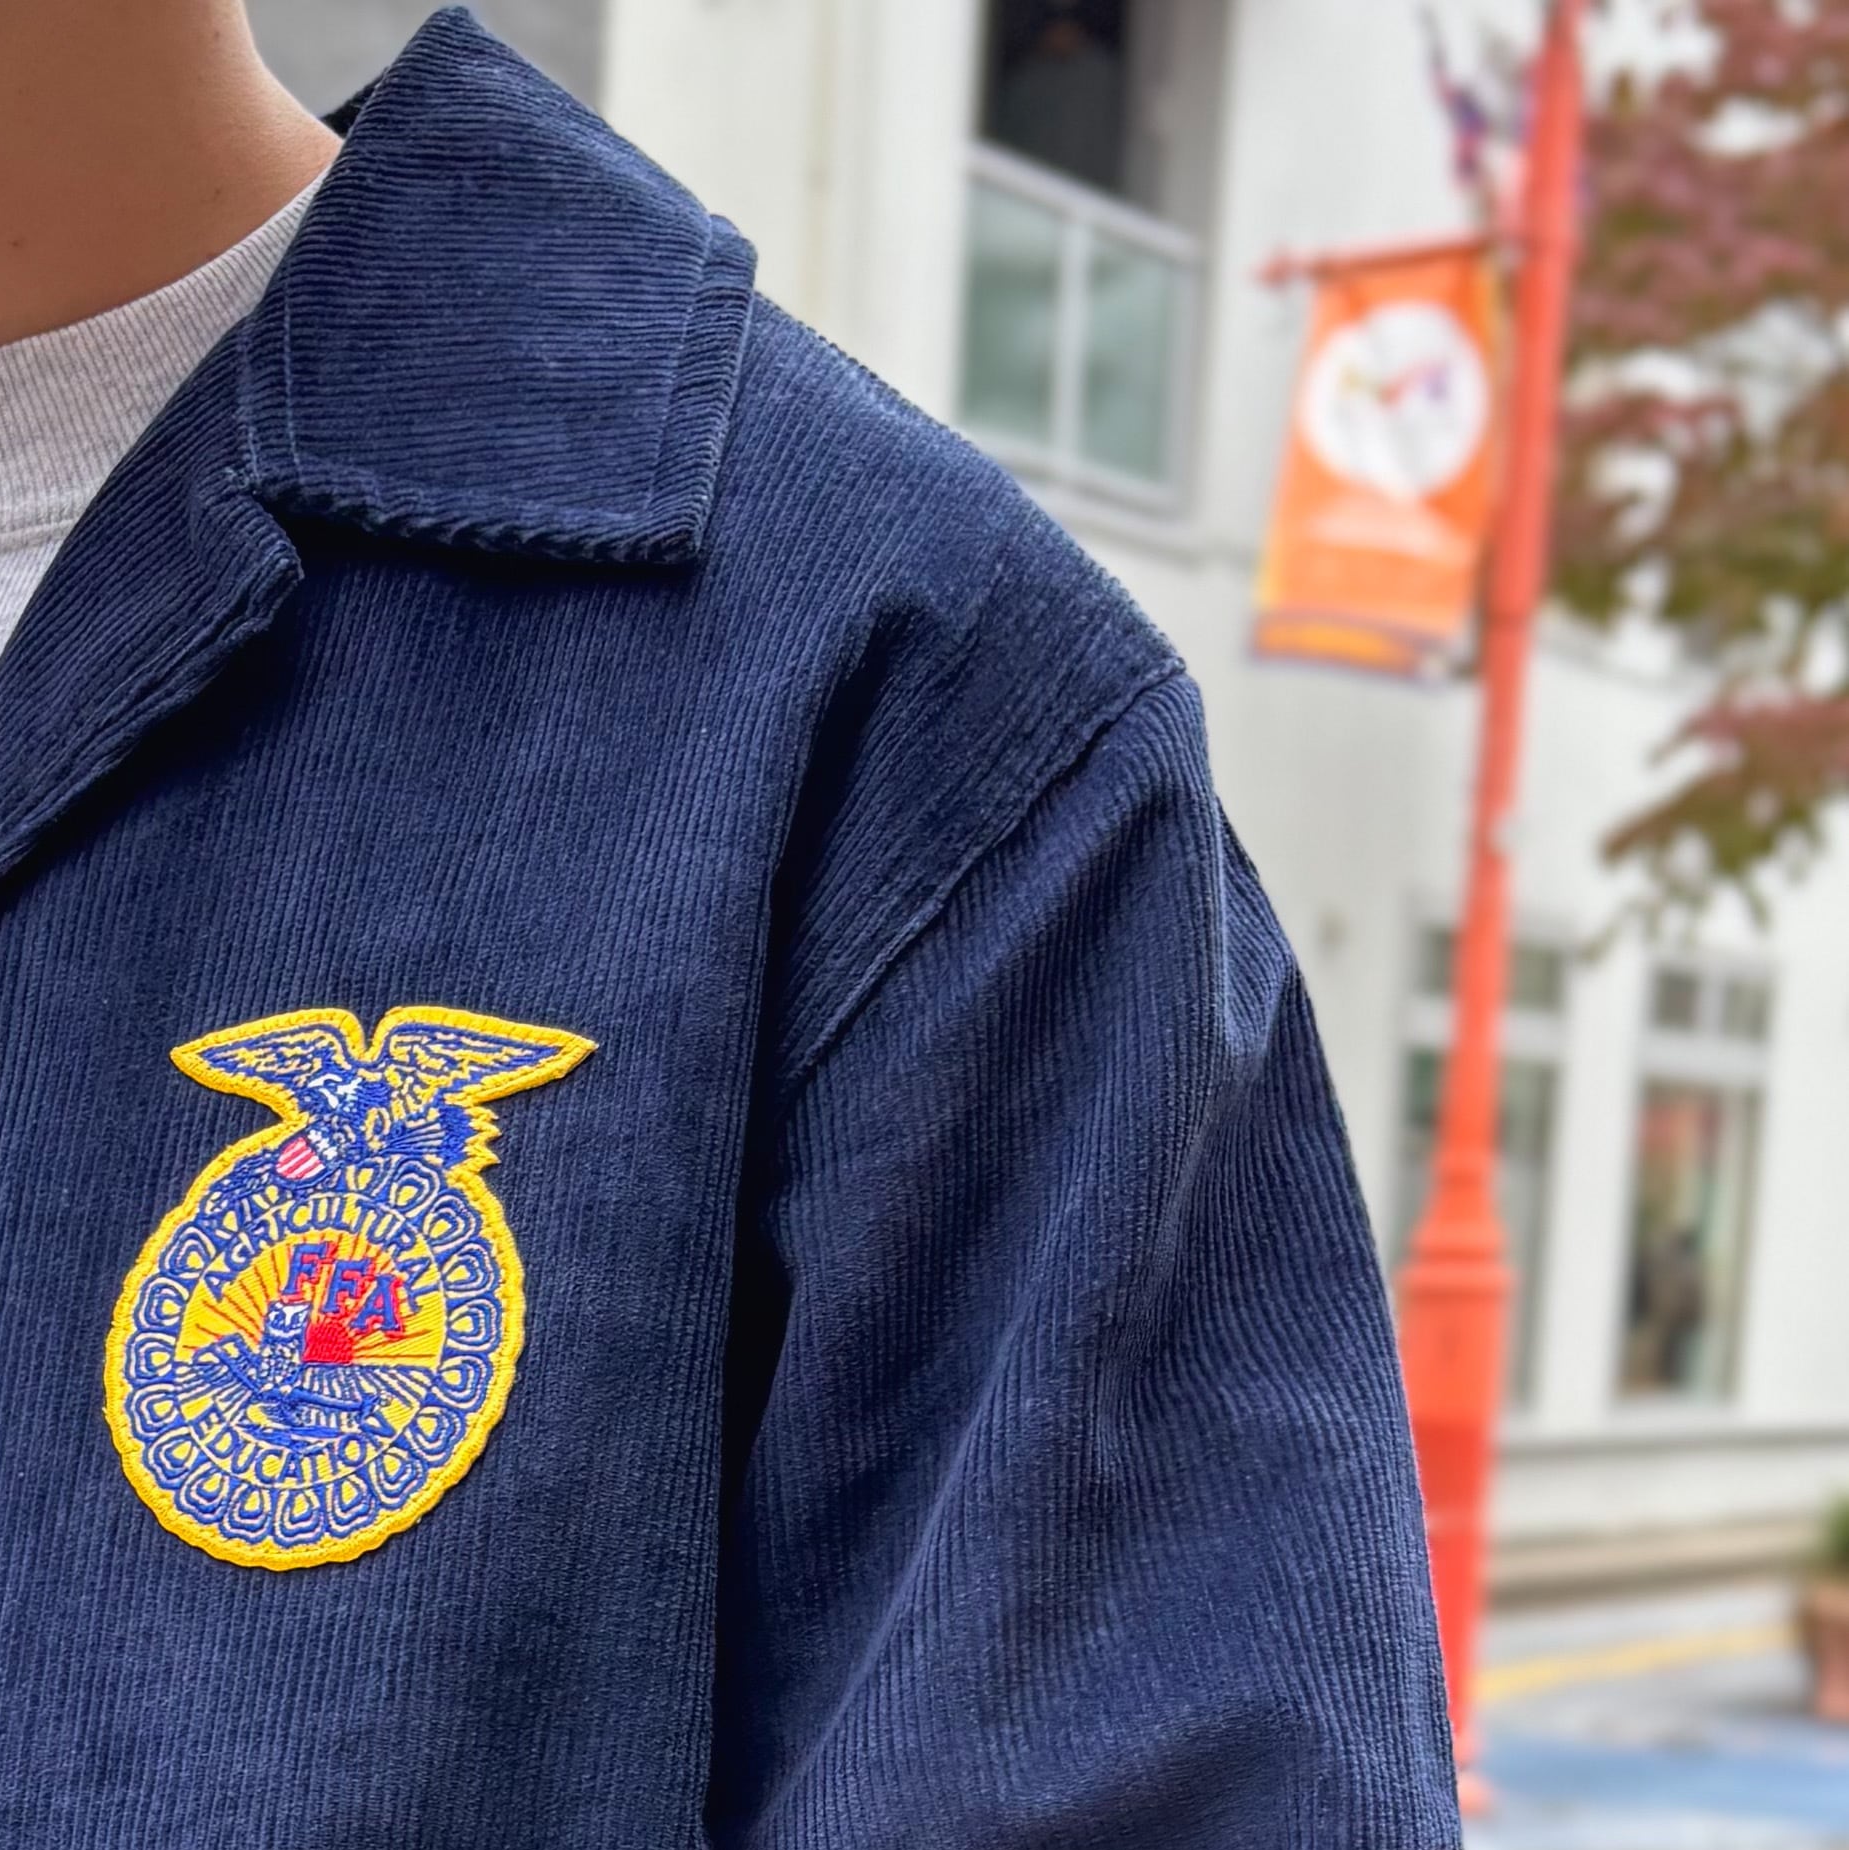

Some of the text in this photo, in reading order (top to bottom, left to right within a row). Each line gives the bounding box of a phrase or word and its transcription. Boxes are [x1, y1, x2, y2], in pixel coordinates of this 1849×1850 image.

[203, 1195, 439, 1312] AGRICULTURAL
[281, 1240, 402, 1333] FFA
[189, 1403, 396, 1484] EDUCATION
